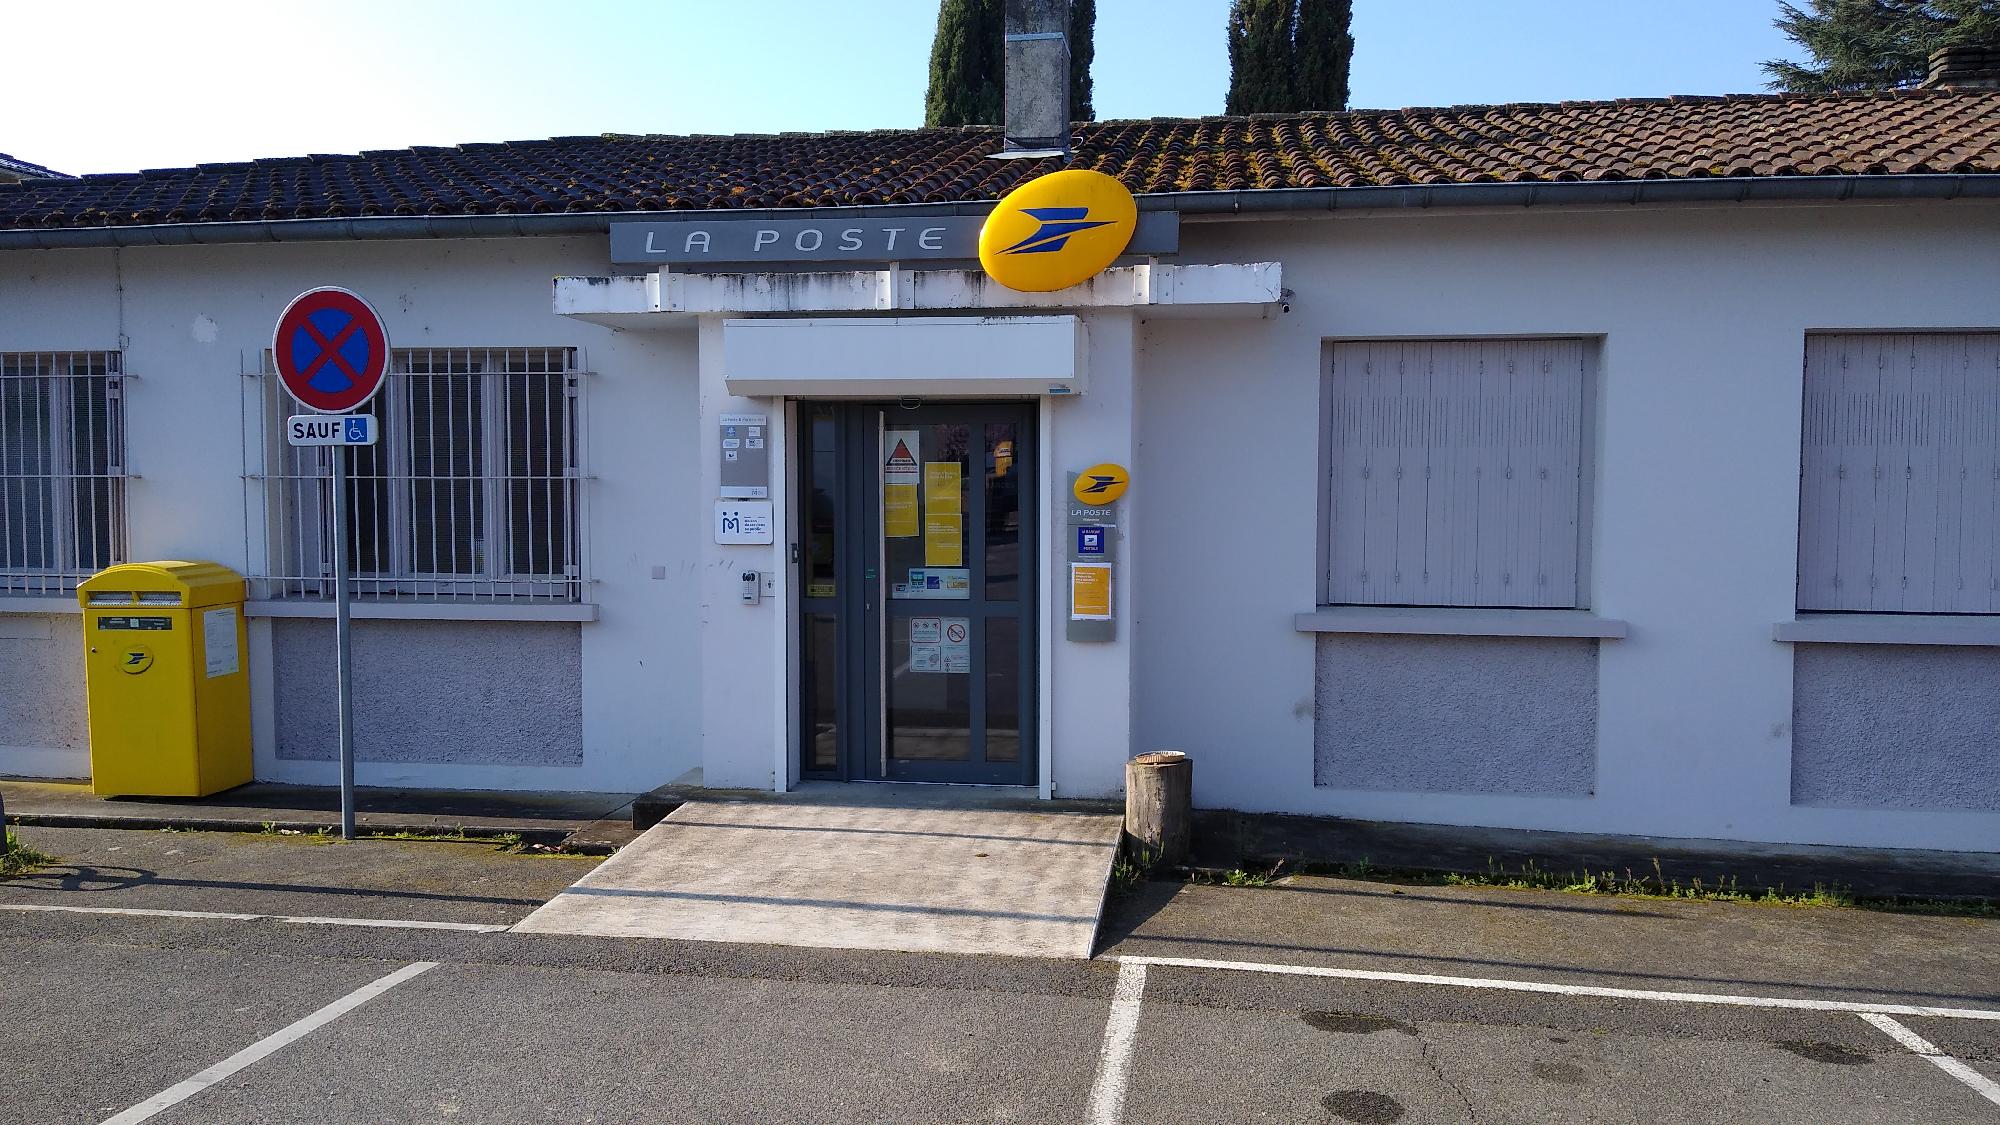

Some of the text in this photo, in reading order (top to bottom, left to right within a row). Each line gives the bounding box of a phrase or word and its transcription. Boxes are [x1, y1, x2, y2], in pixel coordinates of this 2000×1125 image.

[645, 227, 947, 253] LA POSTE
[293, 422, 341, 438] SAUF
